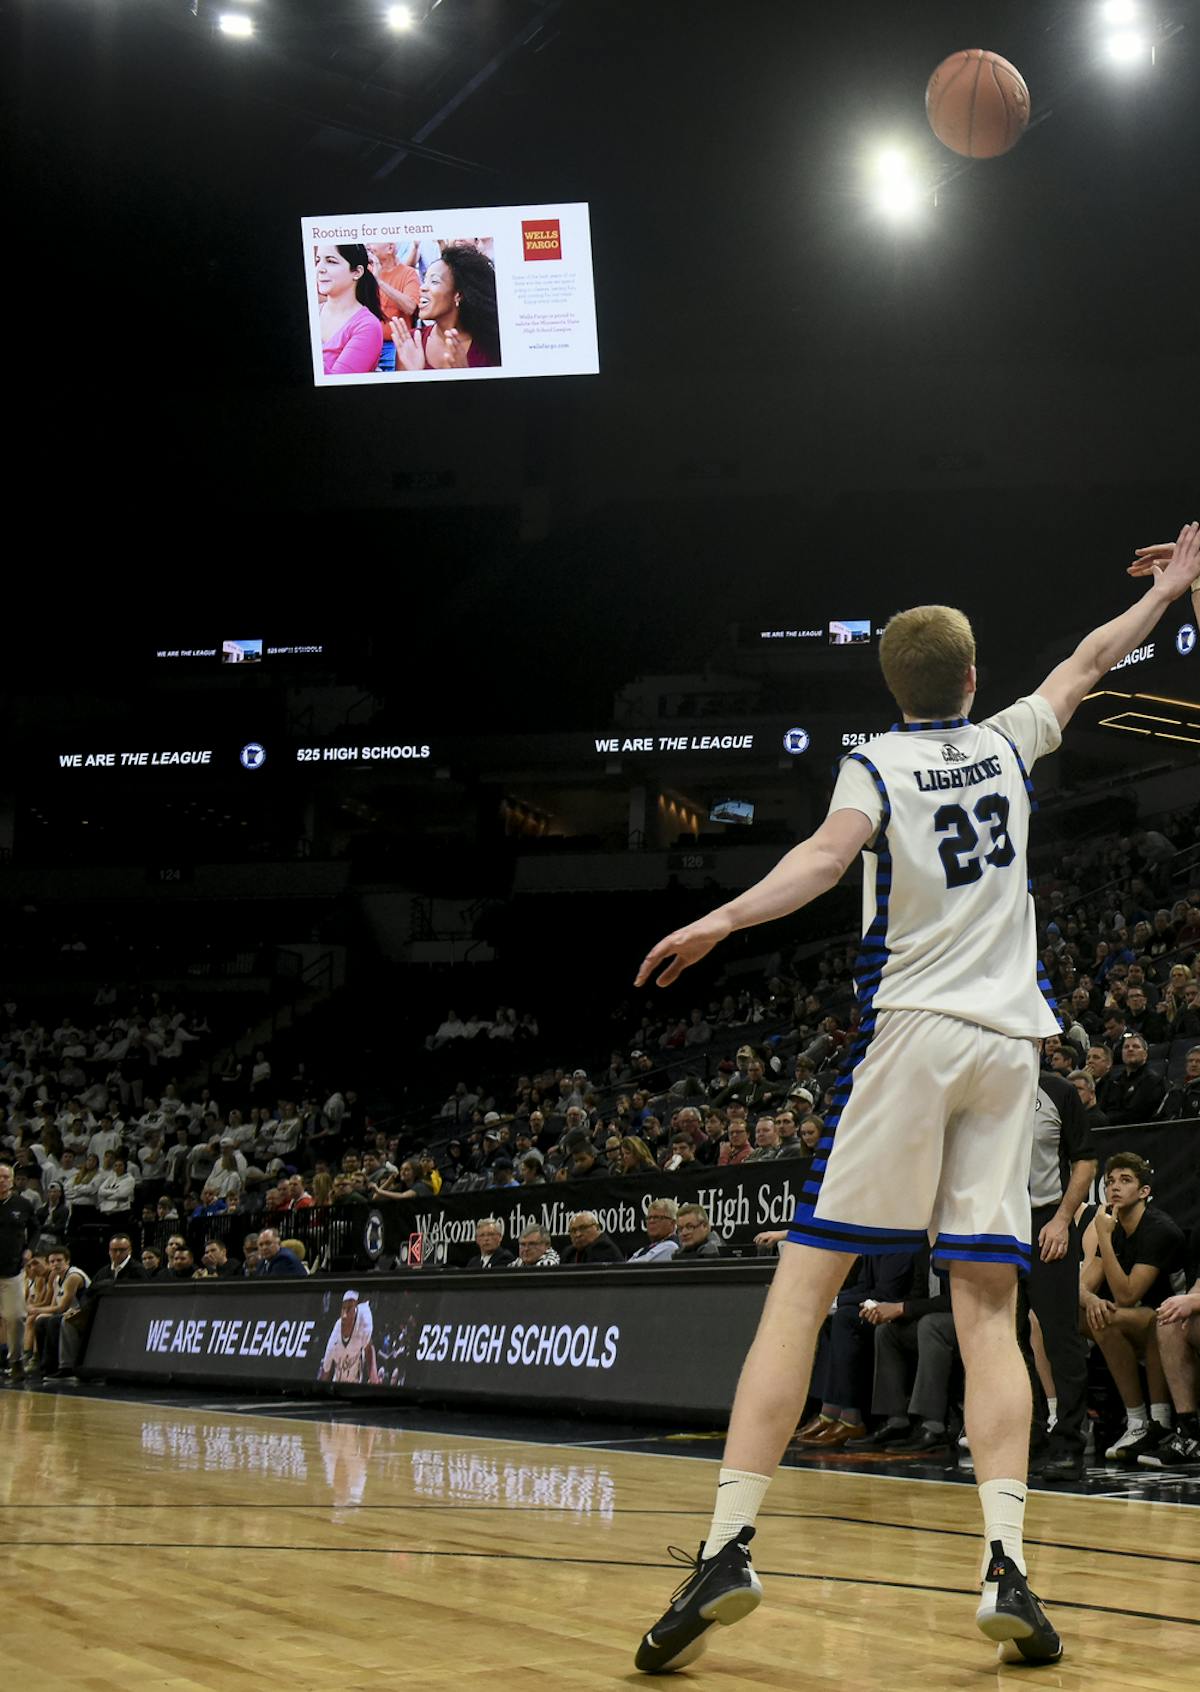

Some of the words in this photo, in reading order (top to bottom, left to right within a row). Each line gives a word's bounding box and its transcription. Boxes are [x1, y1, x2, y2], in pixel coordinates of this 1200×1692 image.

[311, 227, 358, 240] Rooting
[361, 223, 378, 236] for
[380, 226, 401, 236] our
[404, 224, 434, 234] team
[524, 230, 558, 240] WELLS
[526, 239, 559, 250] FARGO
[771, 630, 784, 638] ARE
[798, 629, 823, 637] LEAGUE
[594, 738, 619, 753] WE
[621, 737, 654, 752] ARE
[658, 736, 688, 750] THE
[691, 734, 754, 750] LEAGUE
[841, 733, 867, 746] 525
[59, 754, 83, 768] WE
[85, 753, 116, 767] ARE
[120, 752, 150, 766] THE
[151, 750, 213, 766] LEAGUE
[296, 747, 321, 761] 525
[323, 746, 358, 761] HIGH
[361, 745, 431, 760] SCHOOLS
[933, 792, 1017, 889] 23
[415, 1210, 476, 1243] Welcom
[509, 1203, 537, 1240] the
[541, 1201, 636, 1236] Minsota
[697, 1184, 750, 1240] High
[757, 1180, 796, 1225] Sch
[146, 1319, 173, 1352] WE
[170, 1319, 207, 1354] ARE
[207, 1320, 243, 1355] THE
[239, 1320, 316, 1358] LEAGUE
[416, 1324, 452, 1361] 525
[451, 1324, 506, 1364] HIGH
[506, 1324, 620, 1369] SCHOOLS
